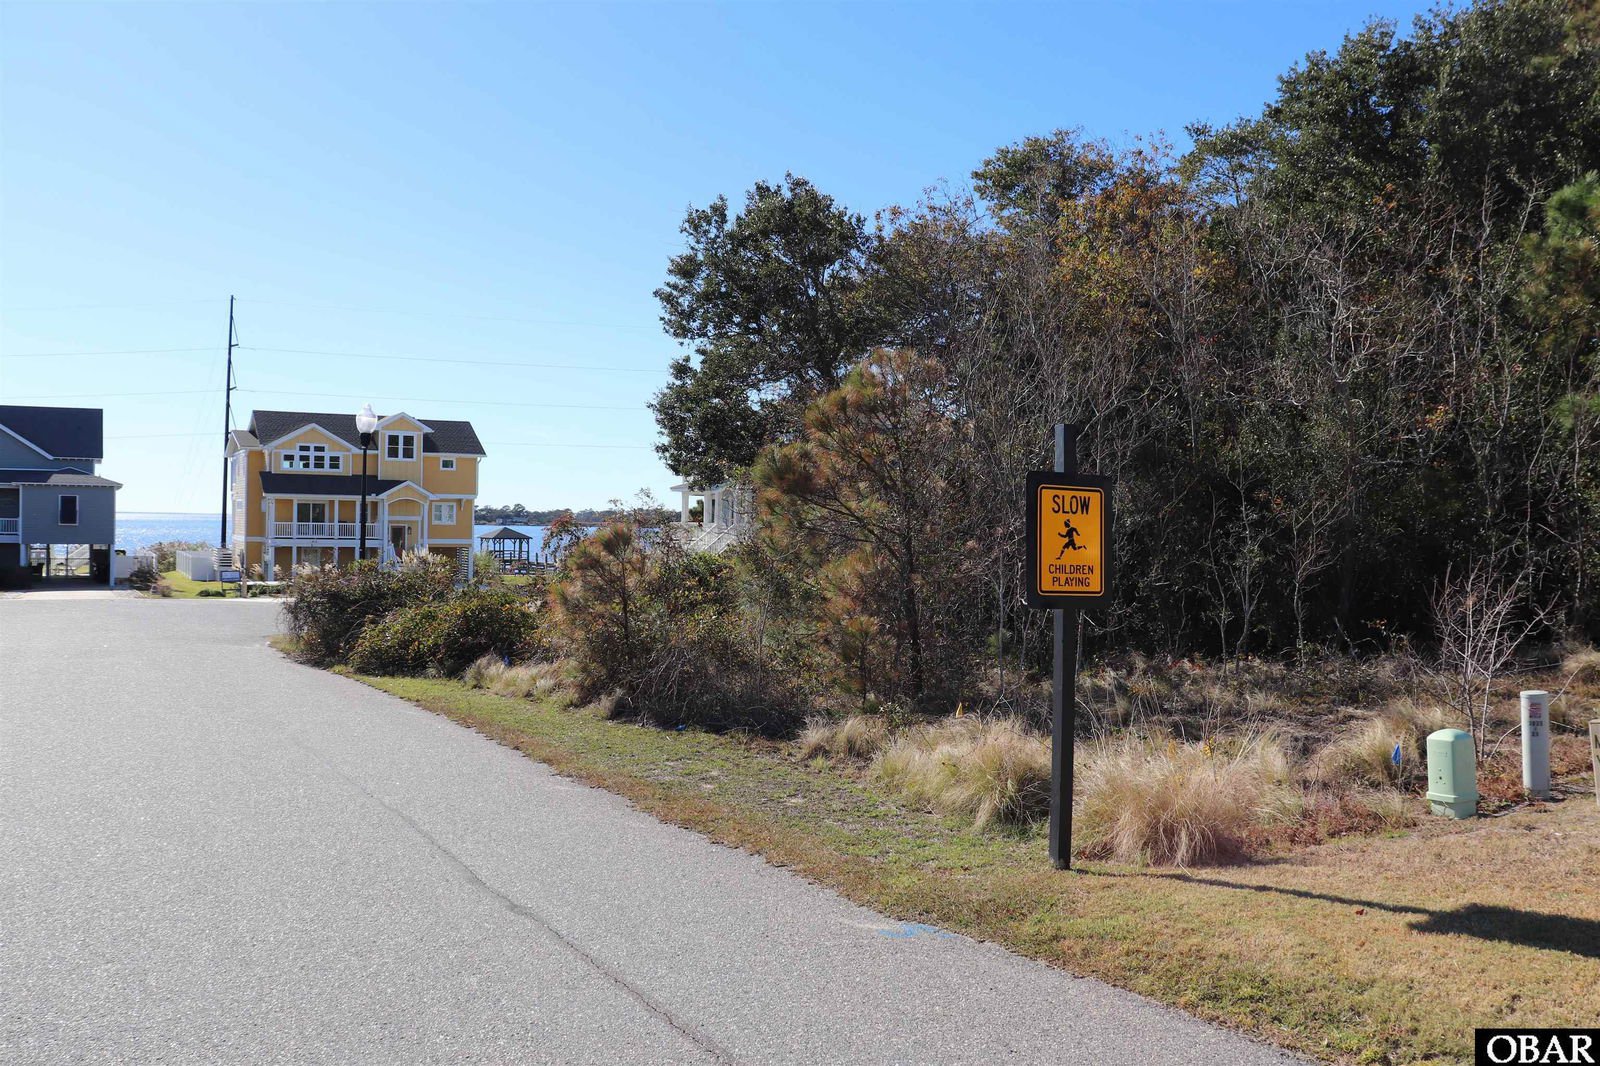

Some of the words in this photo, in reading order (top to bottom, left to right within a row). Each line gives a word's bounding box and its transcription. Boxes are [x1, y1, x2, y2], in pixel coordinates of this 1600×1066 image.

[1052, 494, 1091, 515] SLOW
[1048, 563, 1094, 576] CHILDREN
[1052, 576, 1090, 588] PLAYING
